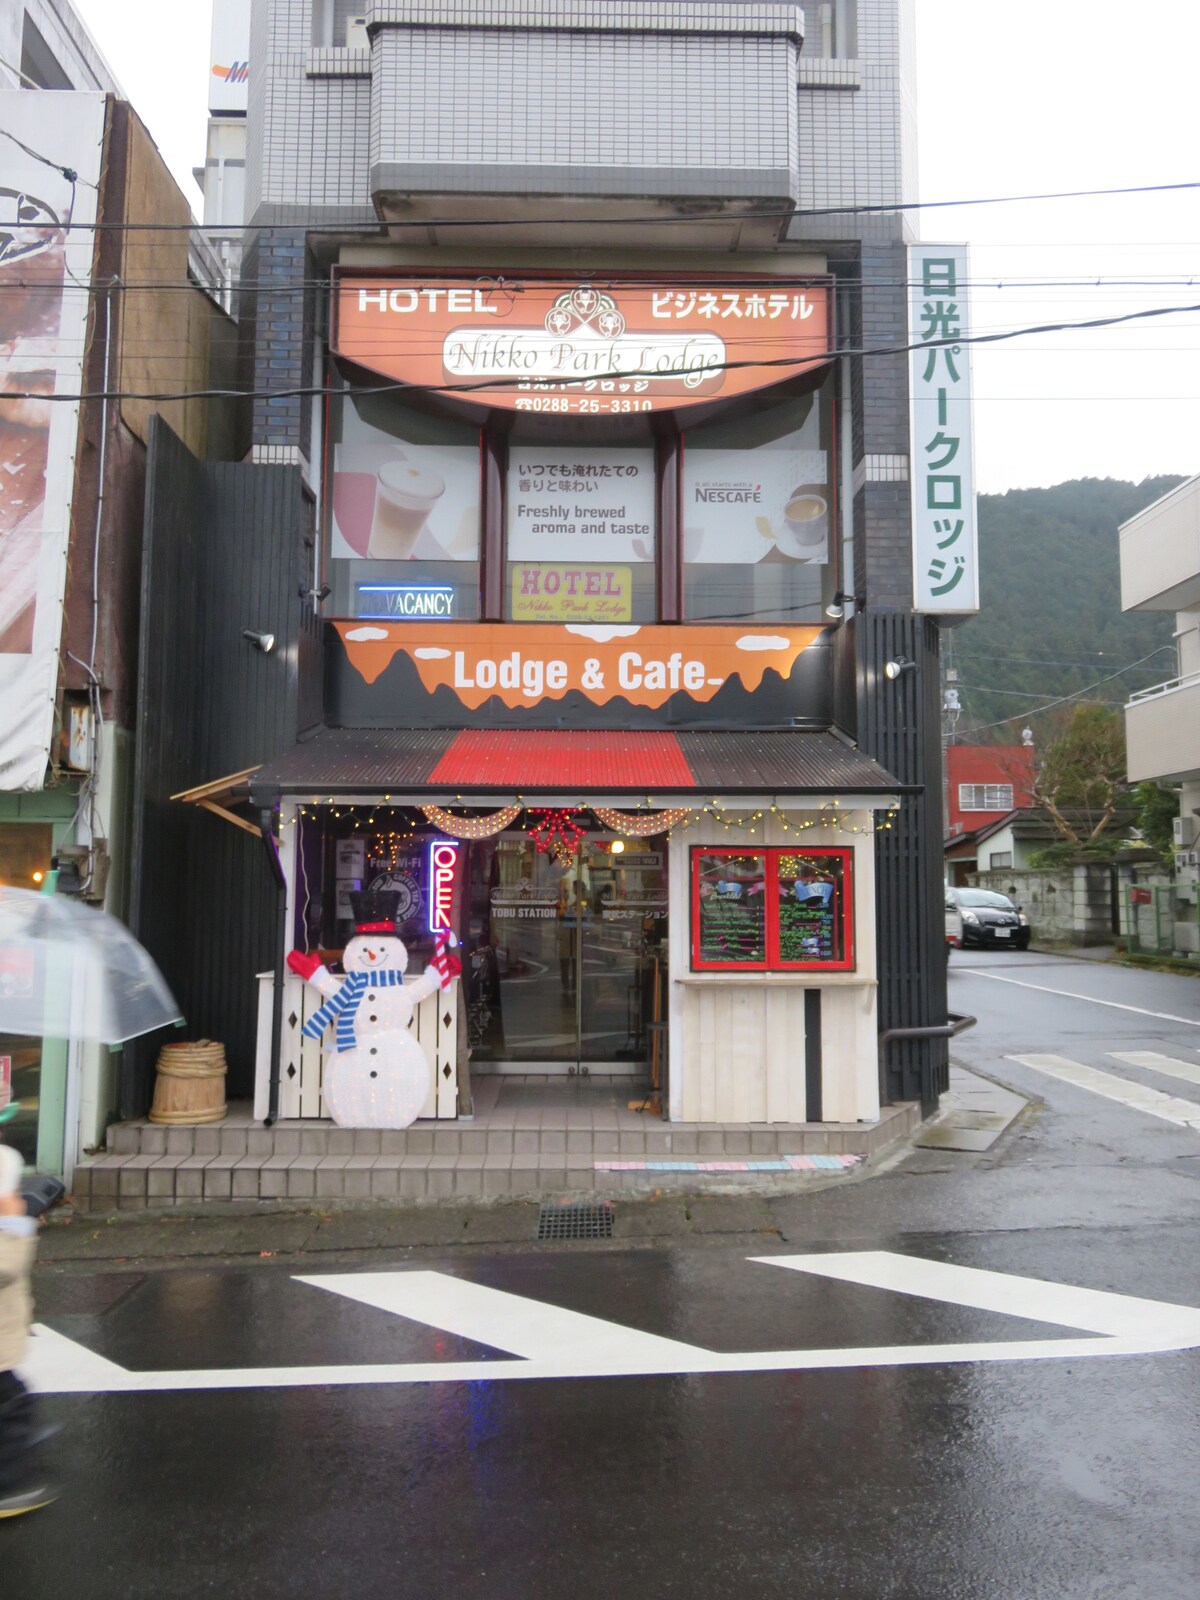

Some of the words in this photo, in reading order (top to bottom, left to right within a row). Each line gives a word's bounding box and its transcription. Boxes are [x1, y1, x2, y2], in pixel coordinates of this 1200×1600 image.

[358, 289, 498, 313] HOTEL
[652, 291, 814, 320] ビジネスホテル
[450, 334, 538, 370] Nikko
[550, 338, 623, 373] Park
[631, 338, 719, 388] Lodge
[533, 397, 652, 413] 0288-25-3310
[921, 258, 966, 597] 日光パークロッジ
[518, 464, 639, 478] いつでも淹れたての
[518, 479, 599, 493] 香りと味わい
[695, 484, 762, 503] NESCAFÉ
[517, 504, 570, 521] Freshly
[574, 505, 626, 519] brewed
[532, 523, 576, 534] aroma
[581, 521, 606, 534] and
[611, 523, 650, 535] taste
[520, 569, 622, 596] HOTEL
[386, 592, 454, 615] VACANCY
[517, 599, 553, 612] Nikko
[560, 599, 589, 613] Park
[594, 600, 627, 616] Lodge
[454, 651, 568, 697] Lodge
[581, 658, 605, 690] &
[618, 652, 705, 690] Cafe
[370, 857, 392, 868] Free
[434, 847, 456, 928] OPEN
[492, 907, 516, 918] TOBU
[517, 907, 557, 918] STATION
